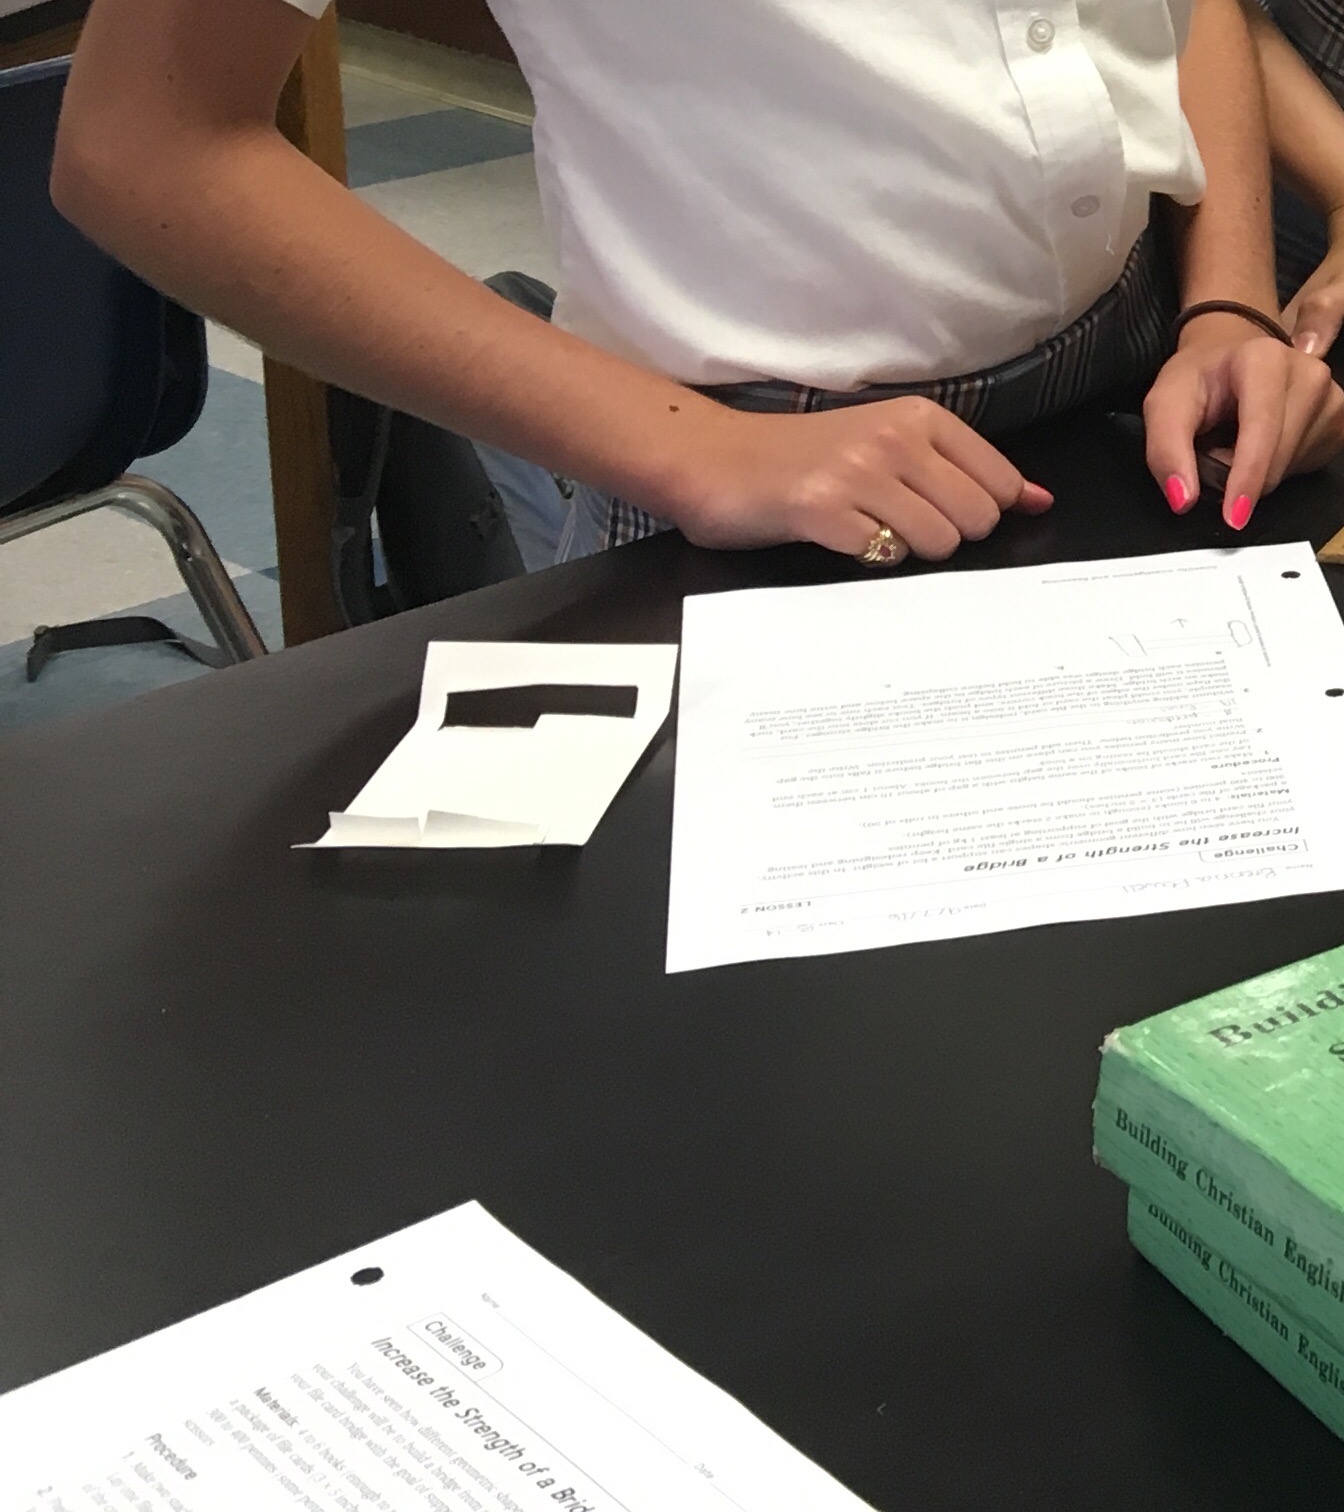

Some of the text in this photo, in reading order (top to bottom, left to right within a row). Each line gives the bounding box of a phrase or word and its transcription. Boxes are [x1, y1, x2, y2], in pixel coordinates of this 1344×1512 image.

[1210, 756, 1279, 769] Procedure
[1178, 836, 1209, 845] the
[1218, 826, 1299, 841] Increase
[1055, 852, 1075, 862] of
[1085, 842, 1169, 858] Strength
[1214, 843, 1298, 858] Challenge
[963, 858, 1027, 871] Bridge
[755, 900, 810, 912] LESSON
[1114, 1108, 1188, 1181] Building
[1195, 1168, 1275, 1247] Christian
[1218, 1258, 1290, 1342] Christian
[425, 1321, 485, 1369] Challenge
[254, 1386, 298, 1427] Materials:
[372, 1337, 433, 1385] Increase
[429, 1386, 460, 1407] the
[455, 1407, 524, 1460] Strength
[518, 1462, 549, 1476] of
[536, 1477, 555, 1489] a
[146, 1433, 196, 1479] Procedure
[694, 1463, 715, 1480] Date
